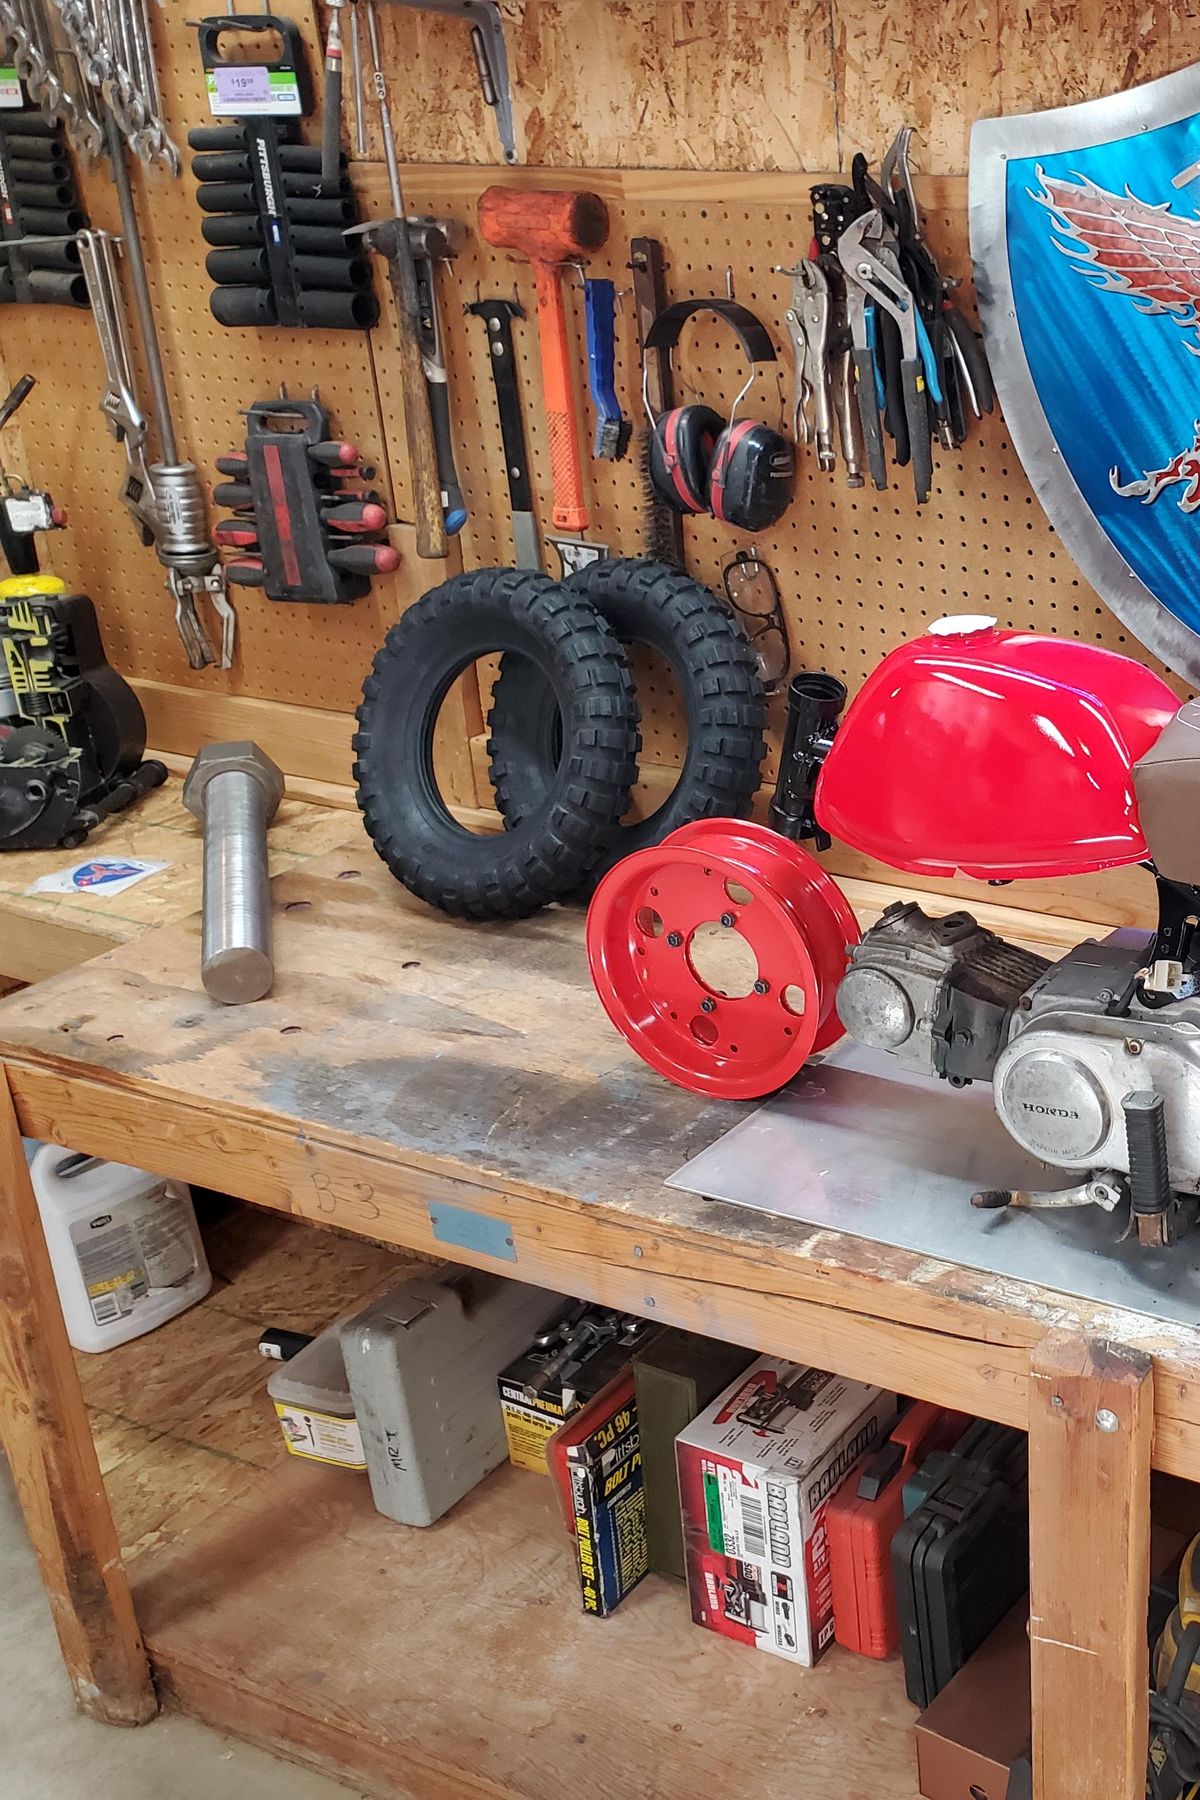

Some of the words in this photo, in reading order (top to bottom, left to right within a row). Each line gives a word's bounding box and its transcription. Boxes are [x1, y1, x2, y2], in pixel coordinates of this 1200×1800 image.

[256, 137, 277, 218] PITTSBURGH
[1022, 1102, 1080, 1120] HONDA
[615, 1410, 630, 1433] 46
[604, 1460, 630, 1496] BOLT
[809, 1415, 878, 1513] BADLAND
[576, 1517, 591, 1539] BOLT
[766, 1481, 791, 1568] BADLAND
[579, 1536, 594, 1565] PULLER
[724, 1533, 736, 1555] 0332
[581, 1563, 595, 1580] SET
[704, 1572, 719, 1610] BADLAND
